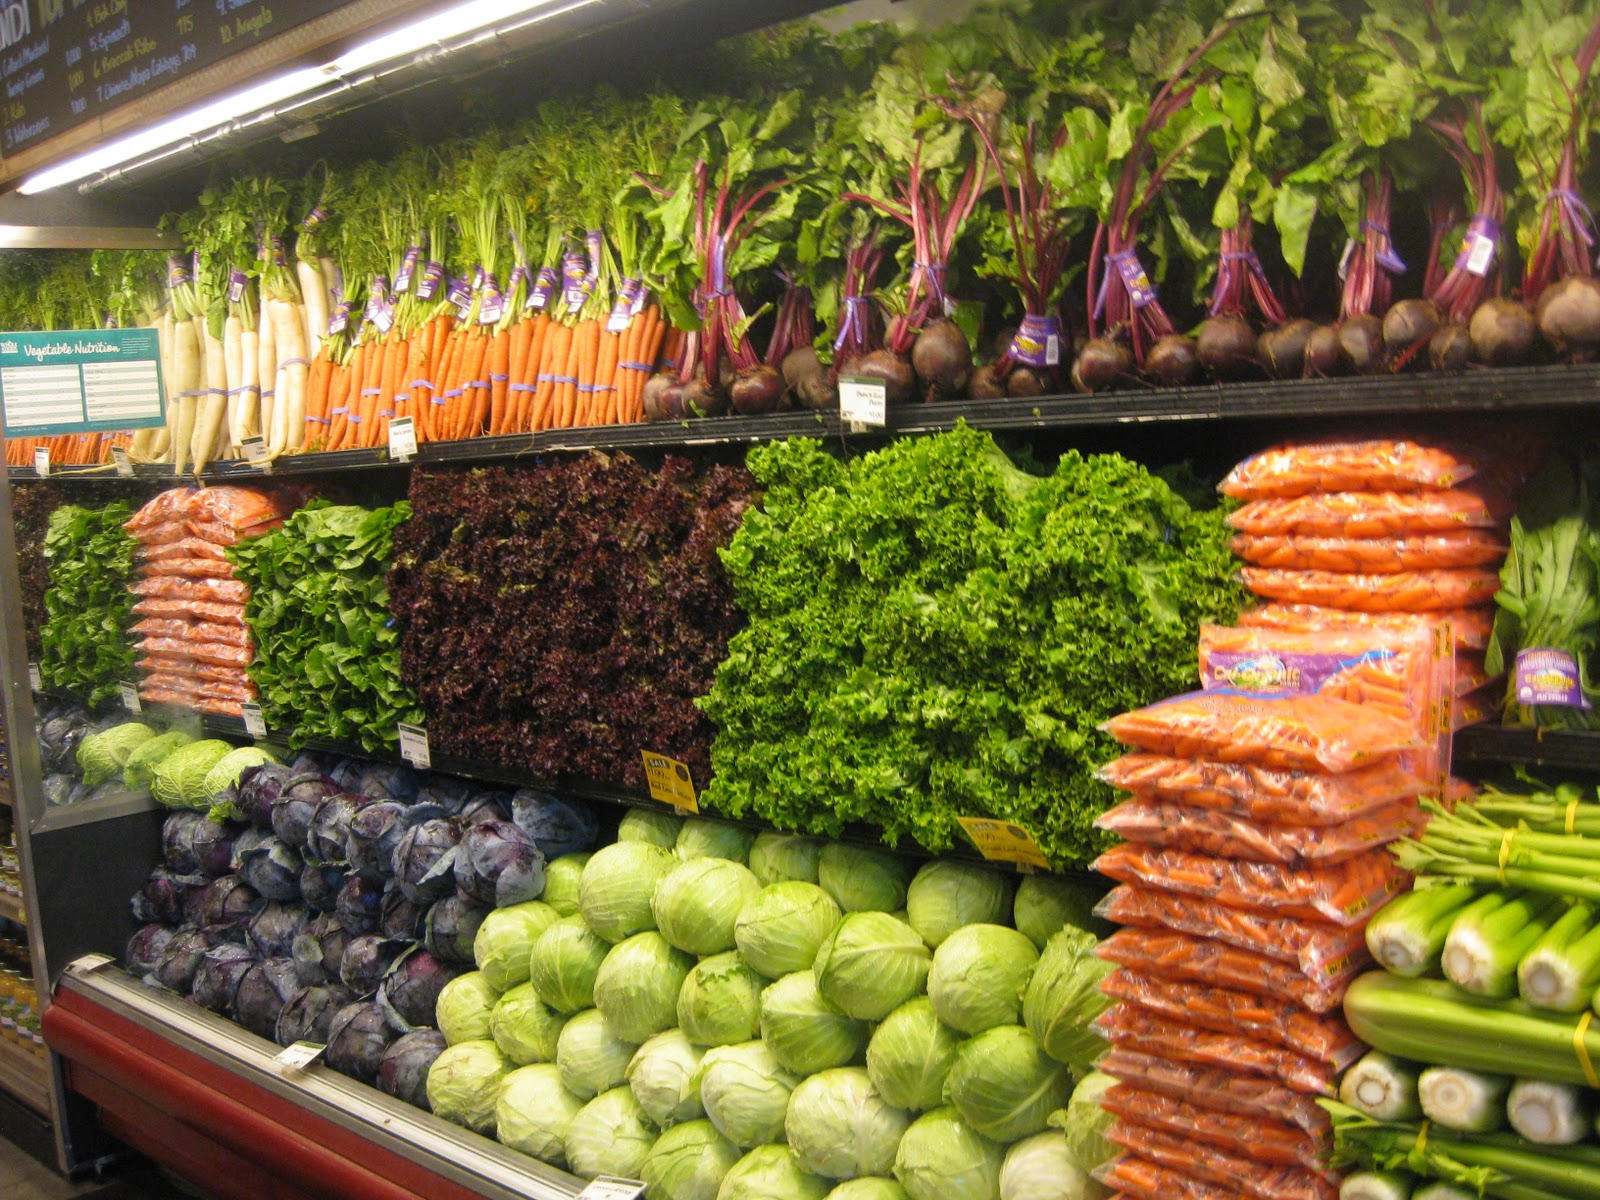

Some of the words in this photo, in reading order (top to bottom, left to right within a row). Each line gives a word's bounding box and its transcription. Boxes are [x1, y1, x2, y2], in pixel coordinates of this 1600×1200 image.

[23, 343, 74, 362] Vegetable
[74, 341, 120, 355] Nutrition
[649, 758, 668, 769] SALE
